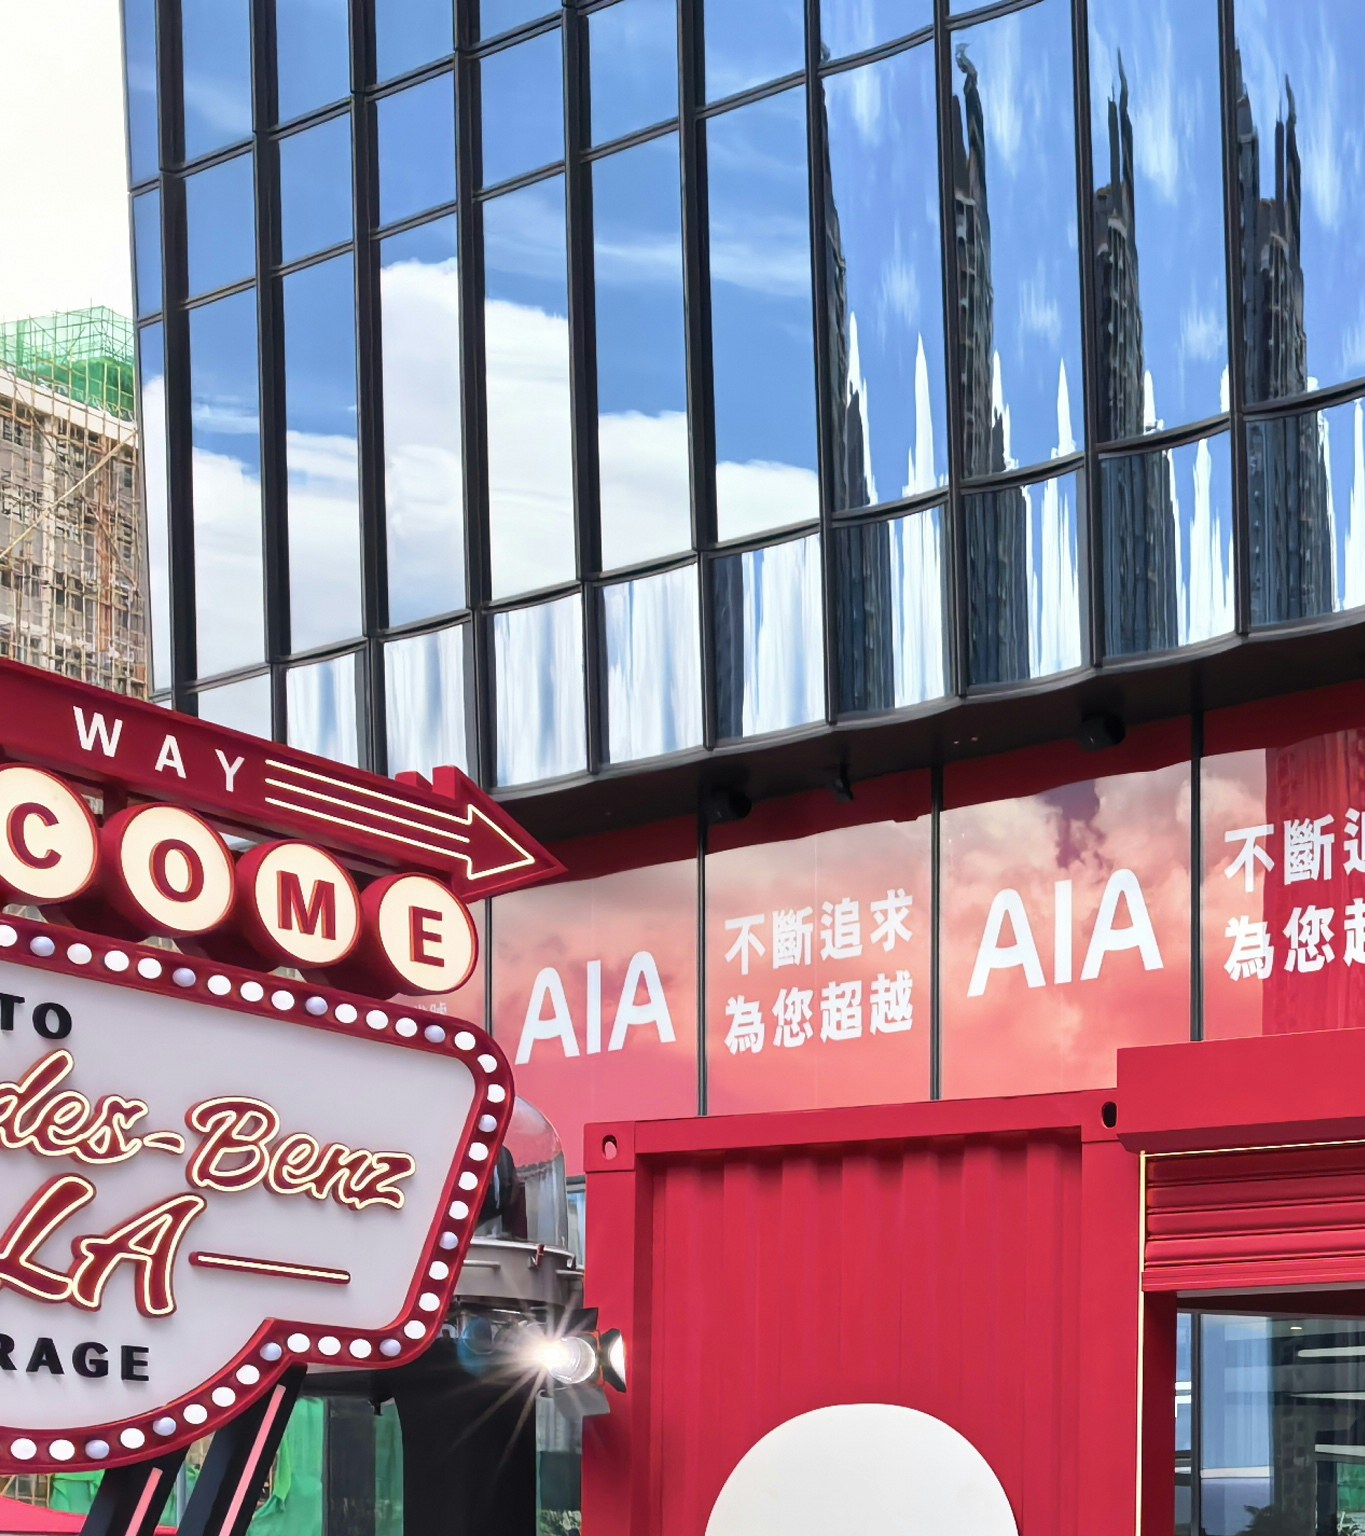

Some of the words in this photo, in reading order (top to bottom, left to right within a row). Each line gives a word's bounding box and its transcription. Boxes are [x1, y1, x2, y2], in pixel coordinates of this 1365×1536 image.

[74, 705, 245, 792] WAY
[6, 802, 445, 969] COME
[724, 888, 914, 975] 不斷追求
[967, 867, 1163, 998] AIA
[514, 950, 677, 1065] AIA
[724, 970, 914, 1055] 為您超越
